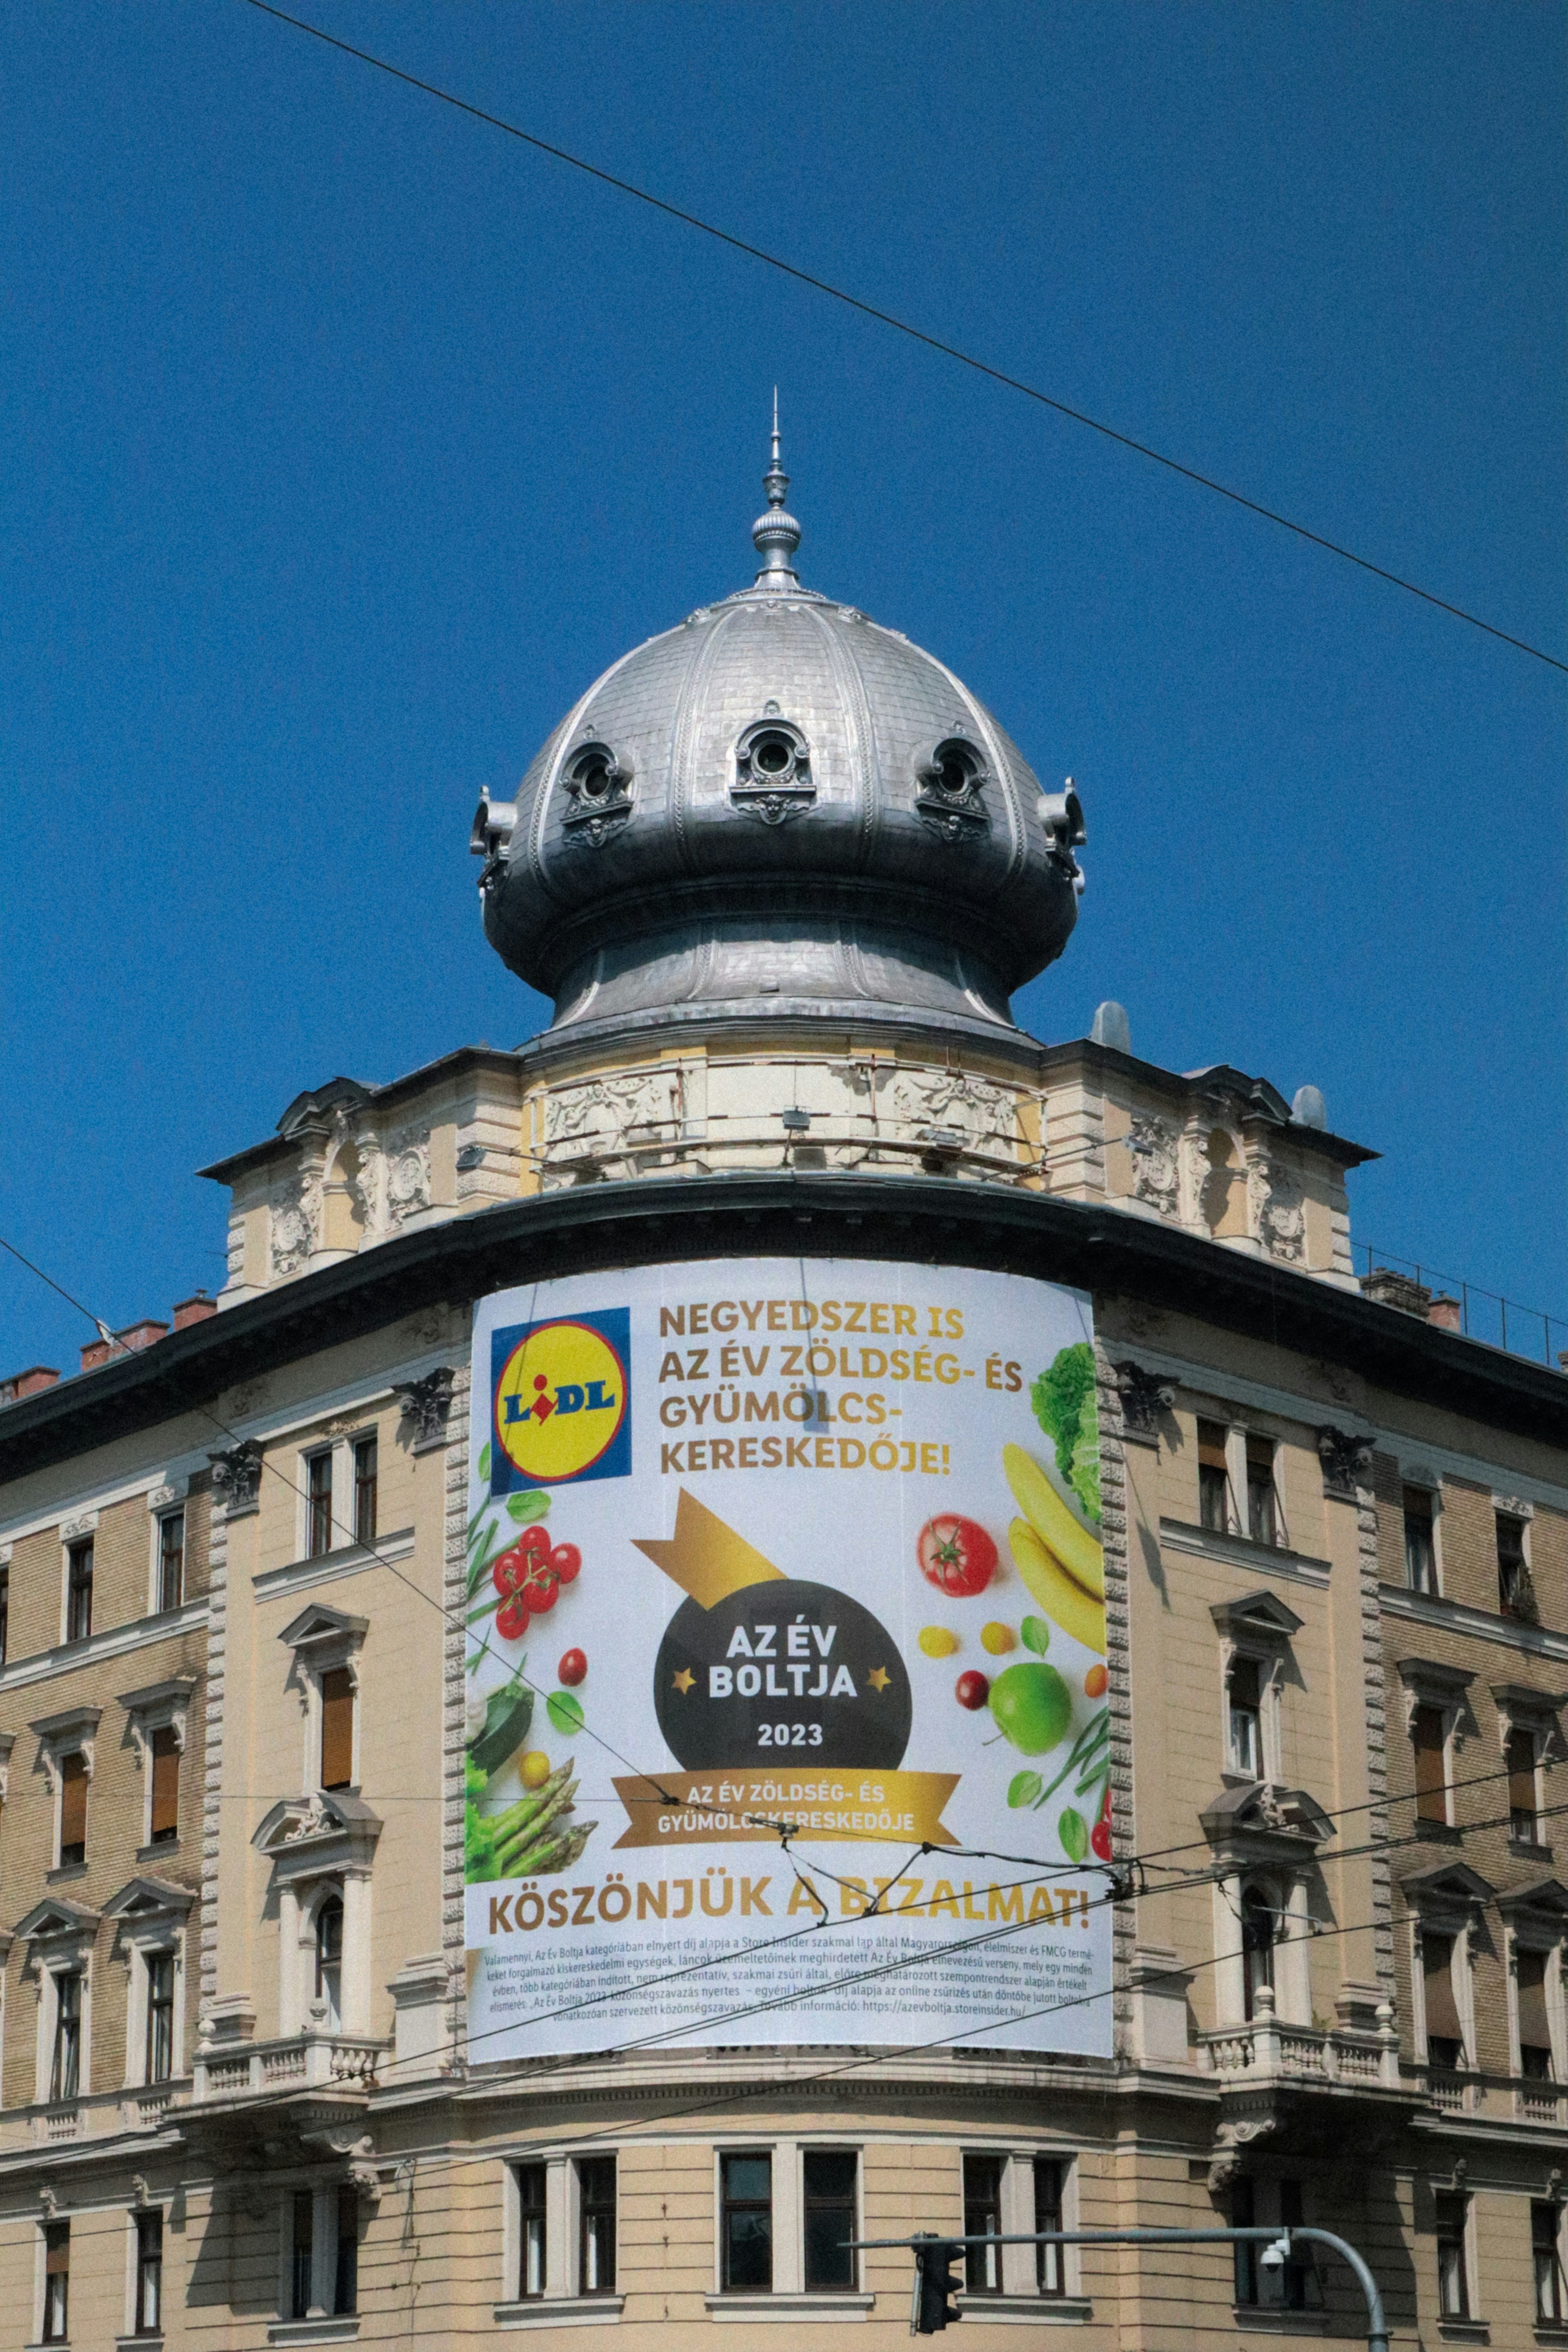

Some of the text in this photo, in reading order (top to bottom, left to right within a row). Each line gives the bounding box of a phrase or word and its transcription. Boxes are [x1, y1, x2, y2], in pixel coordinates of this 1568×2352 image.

[660, 1300, 964, 1339] NEGYEDSZER IS
[659, 1338, 1022, 1392] AZ ÉV ZÖLDSÉG- ÉS
[660, 1383, 902, 1427] GYÜMÖLCS-
[661, 1432, 949, 1475] KERESKEDŐJE!
[726, 1614, 837, 1657] AZ ÉV
[709, 1664, 857, 1697] BOLTJA
[758, 1724, 823, 1746] 2023
[687, 1780, 885, 1804] AZ ÉV ZÖLDSÉG- ÉS
[489, 1867, 1089, 1934] KÖSZÖNJÜK A BIZALMAT!
[485, 1952, 533, 1966] Valamennyi,
[535, 1950, 545, 1960] Az
[548, 1948, 557, 1959] Év
[560, 1946, 583, 1958] Boltja
[586, 1941, 643, 1956] kategóriában
[646, 1940, 680, 1953] elnyert
[684, 1938, 696, 1952] díj
[700, 1938, 730, 1951] alapja
[742, 1937, 769, 1947] Store
[772, 1936, 809, 1947] Insider
[812, 1936, 854, 1947] szakmai
[857, 1936, 873, 1949] lap
[876, 1937, 898, 1947] által
[984, 1942, 1027, 1955] élelmiszer
[1030, 1944, 1039, 1955] és
[1042, 1945, 1066, 1957] FMCG
[1069, 1948, 1094, 1959] termé-
[487, 1971, 506, 1981] keket
[508, 1964, 555, 1980] forgalmazó
[557, 1959, 624, 1973] kiskereskedelmi
[627, 1956, 676, 1969] egységek,
[679, 1953, 712, 1964] láncok
[800, 1953, 867, 1965] meghirdetett
[871, 1953, 883, 1962] Az
[887, 1951, 898, 1963] Év
[985, 1960, 1021, 1971] verseny,
[1023, 1960, 1043, 1973] mely
[1046, 1964, 1061, 1975] egy
[1063, 1963, 1093, 1975] minden
[493, 1986, 518, 1996] évben,
[520, 1983, 539, 1993] több
[541, 1977, 595, 1993] kategóriában
[598, 1975, 633, 1986] indított,
[637, 1975, 658, 1983] nem
[733, 1969, 775, 1980] szakmai
[806, 1968, 831, 1980] által,
[940, 1972, 1022, 1986] szempontrendszer
[1024, 1976, 1055, 1989] alapján
[1057, 1978, 1087, 1990] értékelt
[490, 2000, 527, 2013] elismerés.
[546, 1996, 556, 2007] Év
[559, 1994, 583, 2007] Boltja
[702, 1987, 740, 1999] nyertes
[755, 1985, 790, 1997] egyéni
[851, 1985, 882, 1996] alapja
[886, 1987, 896, 1995] az
[899, 1985, 930, 1996] online
[973, 1989, 993, 2000] után
[1033, 1991, 1056, 2004] jutott
[610, 2005, 657, 2017] szervezett
[800, 2000, 860, 2012] információ:
[863, 2000, 1026, 2017] https://azevboltja.storeinsider.hu/
